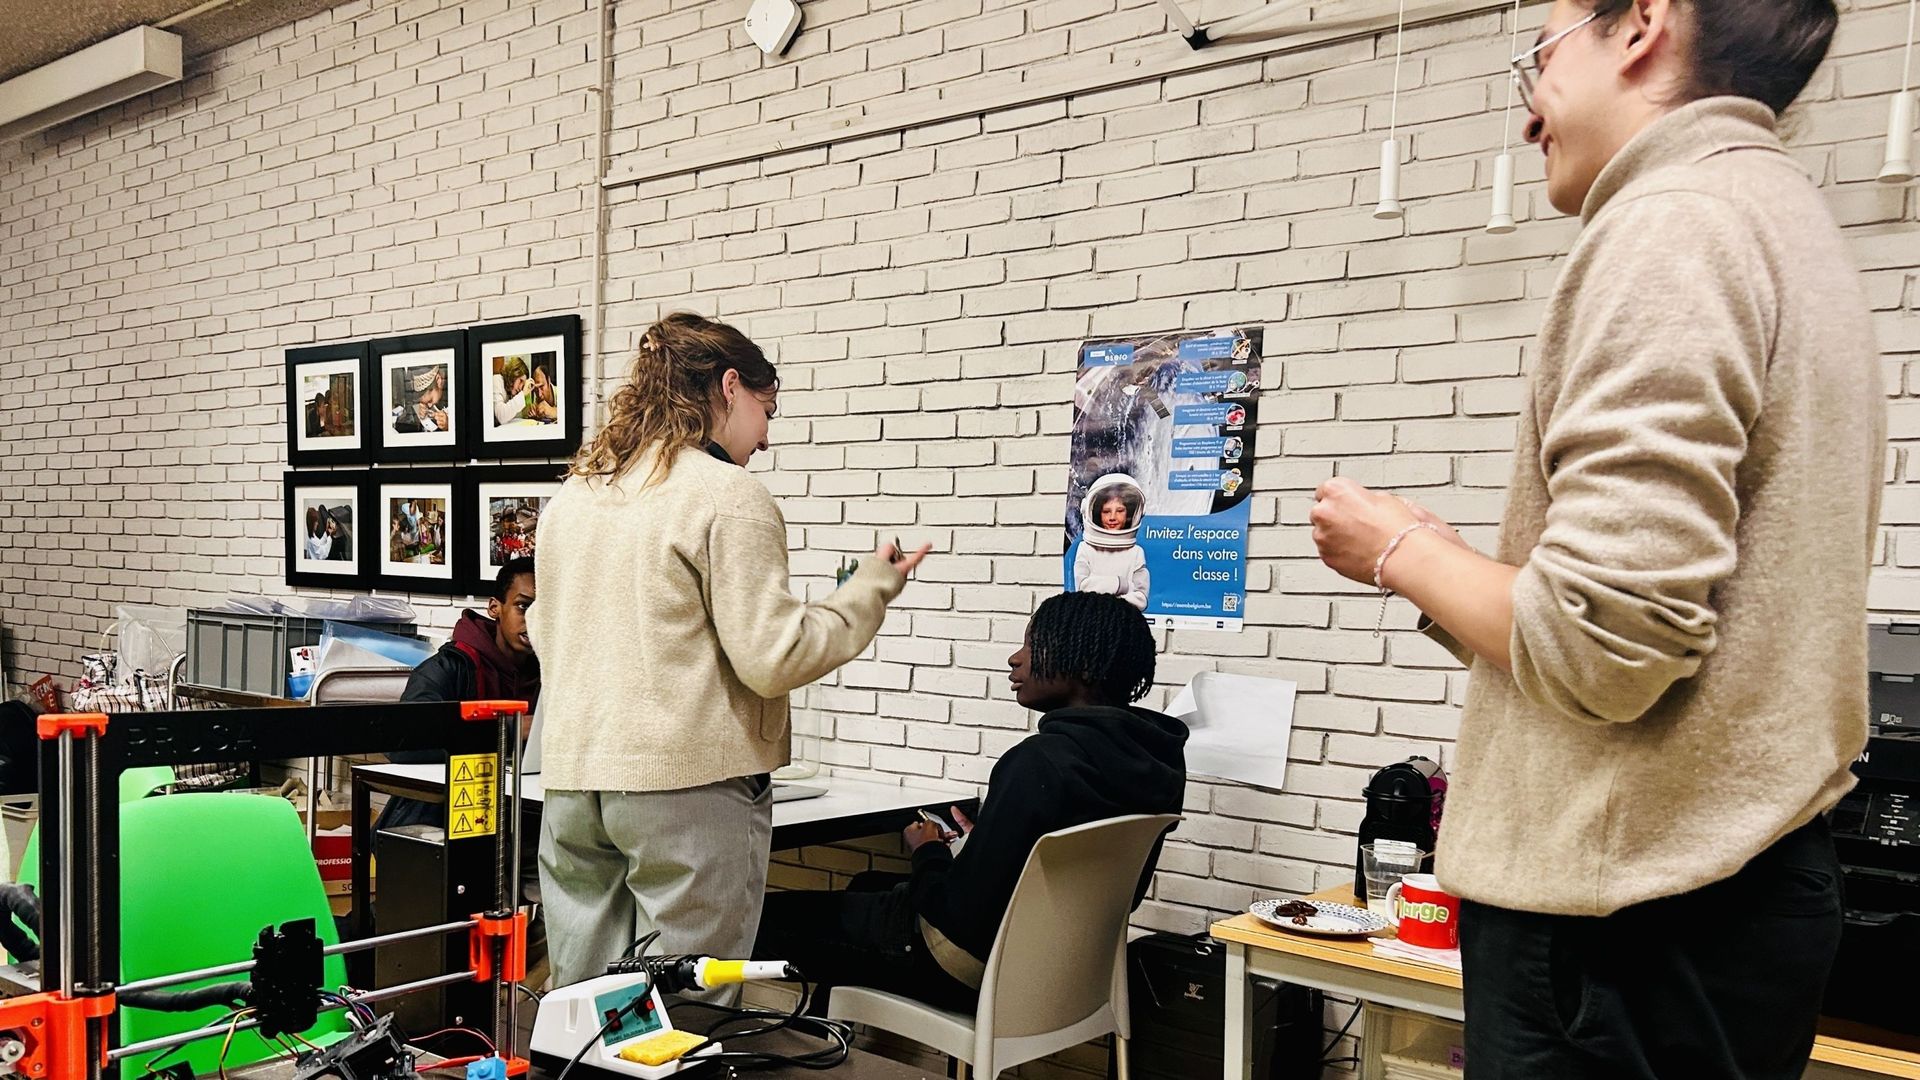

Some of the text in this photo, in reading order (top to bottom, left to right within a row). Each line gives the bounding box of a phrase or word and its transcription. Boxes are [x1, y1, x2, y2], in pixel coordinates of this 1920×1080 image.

[1146, 524, 1240, 543] Invitez l'espace
[1172, 544, 1238, 560] dans votre
[1192, 565, 1238, 581] classe !
[1399, 896, 1449, 923] large
